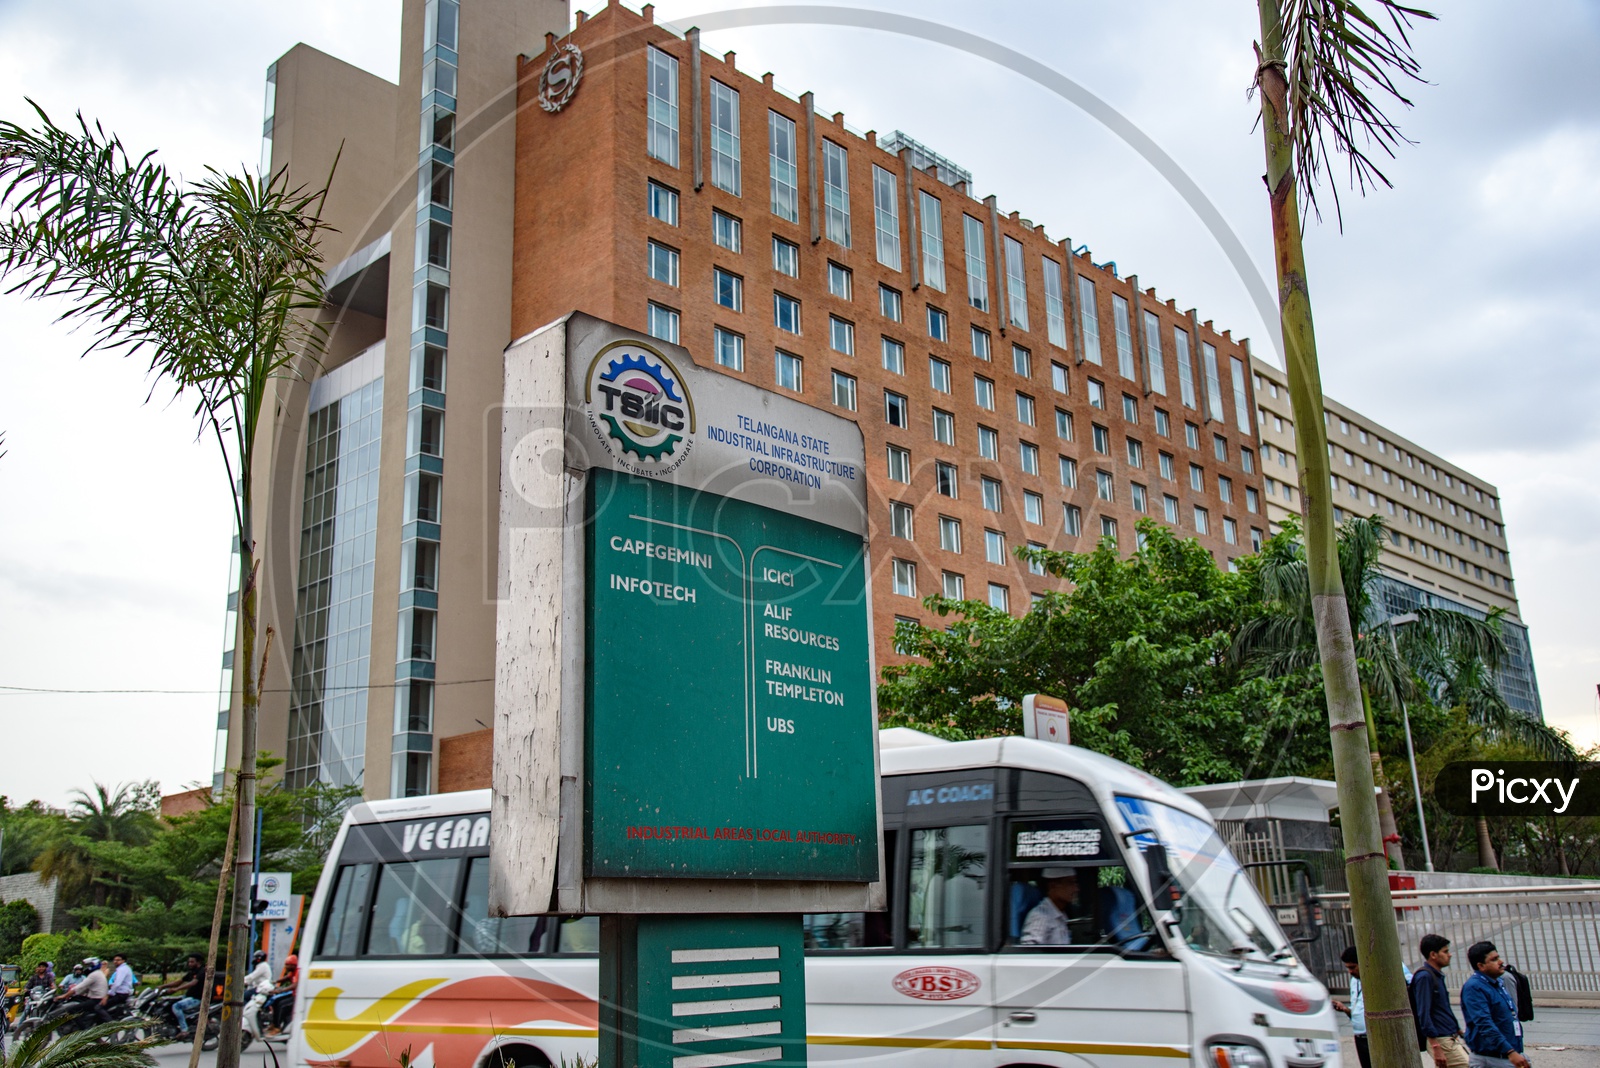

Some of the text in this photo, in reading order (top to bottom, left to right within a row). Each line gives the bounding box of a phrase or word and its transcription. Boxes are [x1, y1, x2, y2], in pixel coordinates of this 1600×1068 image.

[587, 410, 694, 477] INNOVATE INCUBATE INCORPORATE
[737, 414, 830, 455] TELANGANA STATE
[707, 425, 855, 480] INDUSTRIAL INFRASTRUCTURE
[750, 457, 821, 490] CORPORATION
[610, 536, 712, 569] CAPEGEMINI
[610, 573, 696, 603] INFOTECH
[763, 567, 794, 587] ICICI
[764, 603, 793, 621] ALIF
[764, 623, 840, 652] RESOURCES
[765, 659, 832, 684] FRANKLIN
[766, 680, 844, 707] TEMPLETON
[766, 717, 795, 735] UBS
[936, 783, 995, 804] COACH
[402, 816, 491, 853] VEERA
[626, 825, 857, 846] INDUSTRIAL AREAS LOCAL AUTHORITY
